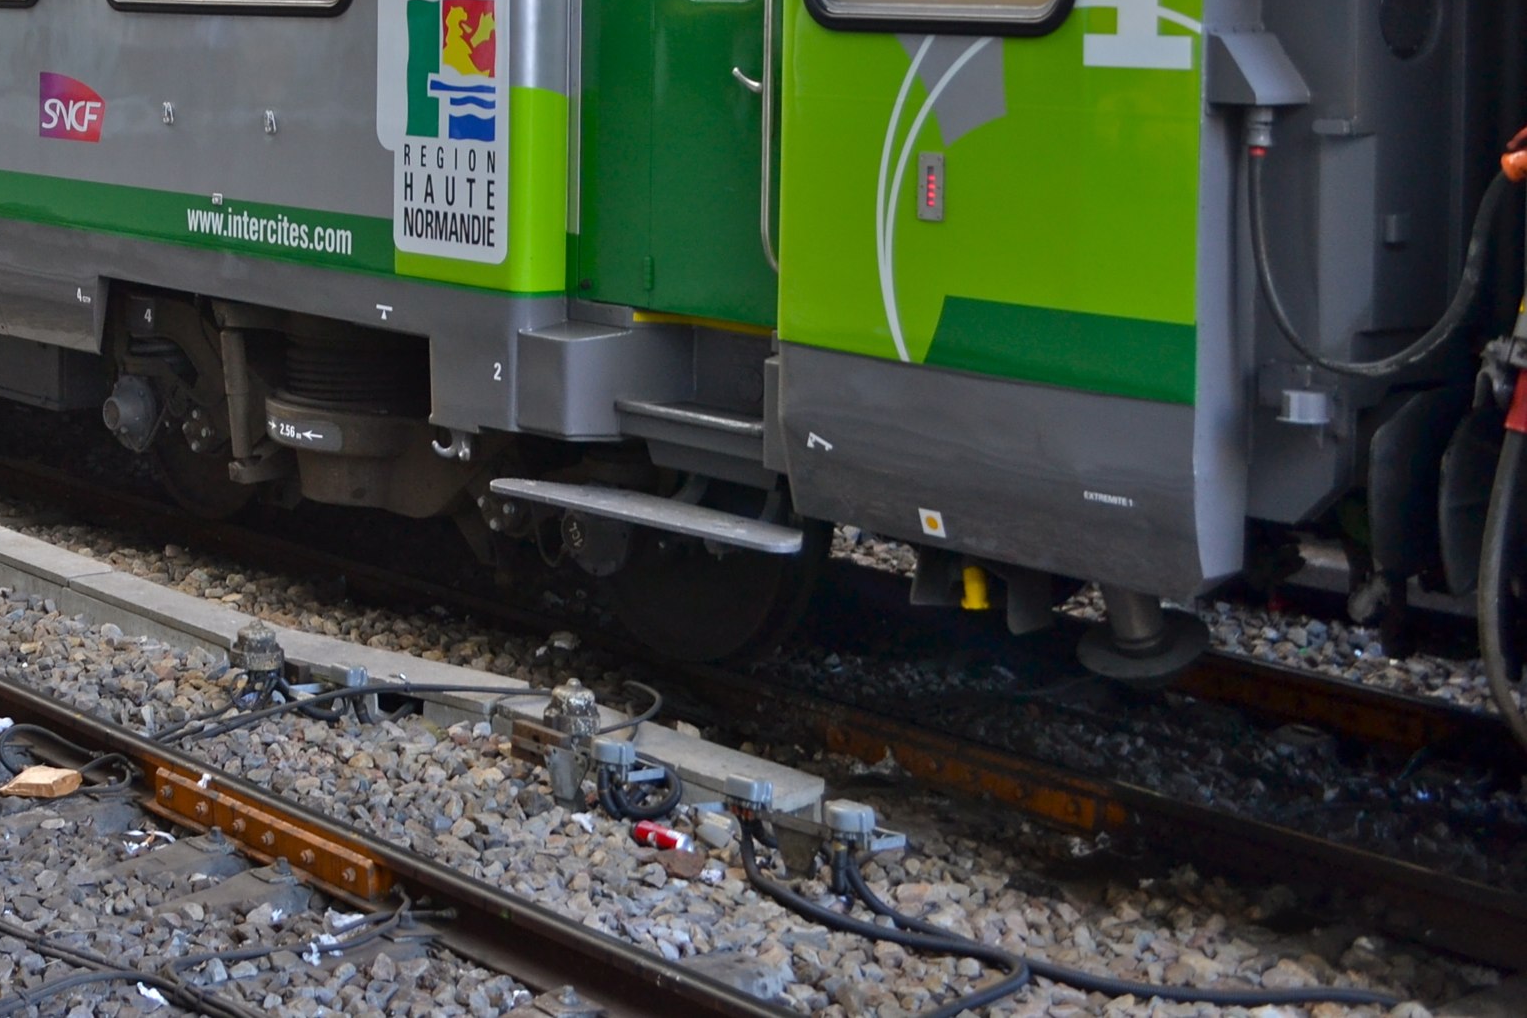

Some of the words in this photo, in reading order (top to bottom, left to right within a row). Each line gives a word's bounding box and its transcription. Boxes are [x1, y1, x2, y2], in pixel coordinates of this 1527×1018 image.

[41, 98, 102, 132] SNCF
[404, 143, 495, 174] REGION
[404, 171, 495, 210] HAUTE
[187, 207, 352, 255] www.intercites.com
[404, 206, 495, 247] NORMANDIE
[144, 308, 152, 322] 4
[493, 362, 502, 381] 2
